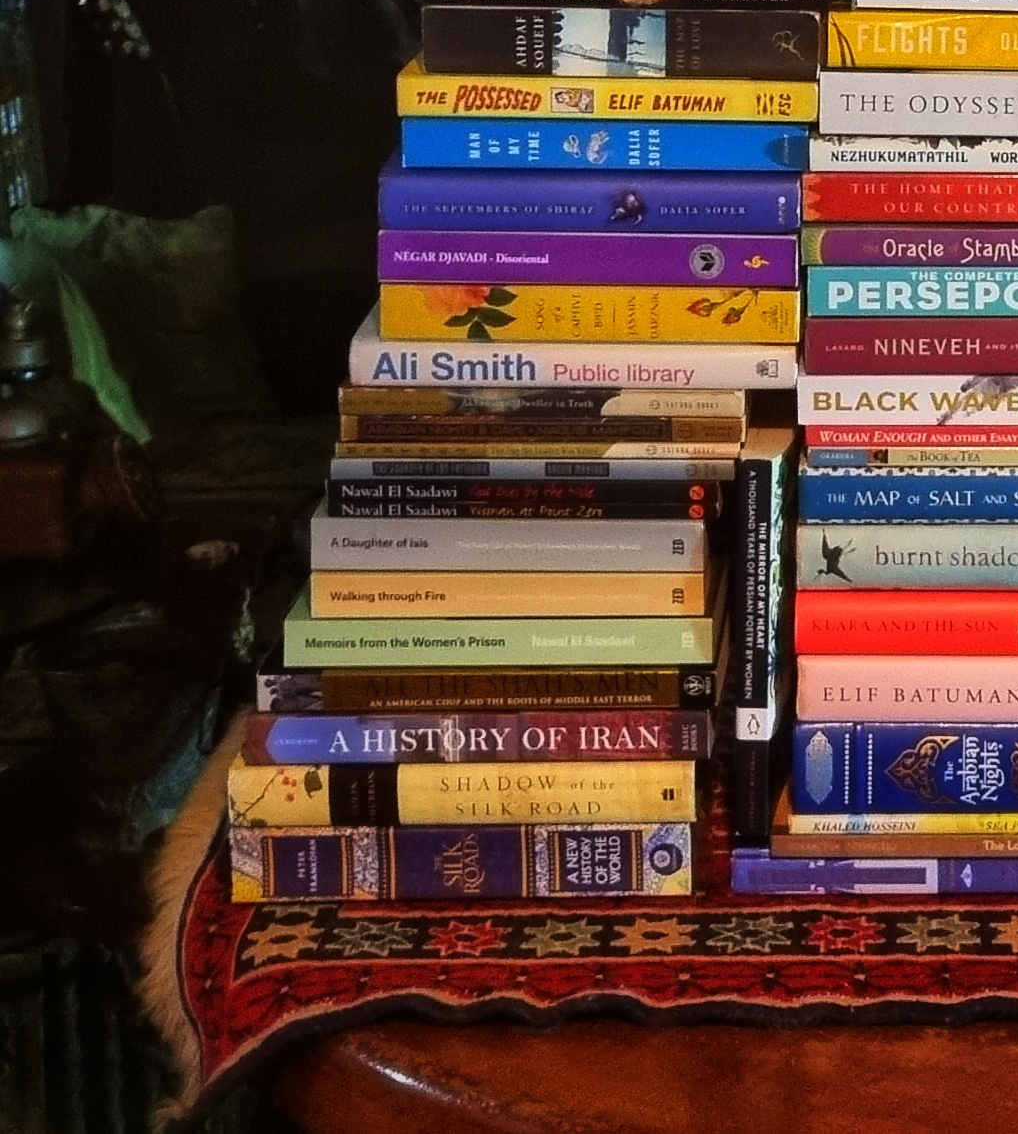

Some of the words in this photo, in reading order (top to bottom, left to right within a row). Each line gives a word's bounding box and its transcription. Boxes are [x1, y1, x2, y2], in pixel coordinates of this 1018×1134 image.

[416, 91, 447, 104] THE
[453, 85, 542, 113] POSSESSED
[608, 94, 643, 110] ELIF
[652, 95, 726, 112] BATUMAN
[840, 93, 895, 113] THE
[470, 132, 480, 159] MAN
[490, 139, 500, 153] OF
[510, 138, 519, 155] MY
[529, 132, 539, 160] TIME
[630, 129, 640, 165] DALIA
[649, 129, 660, 166] SOFER
[830, 151, 968, 163] NEZHUKUMATATHIL
[910, 271, 939, 280] THE
[372, 353, 417, 380] Ali
[431, 352, 536, 381] Smith
[553, 363, 621, 381] Public
[627, 364, 695, 385] library
[812, 391, 920, 412] BLACK
[827, 493, 846, 504] THE
[854, 490, 900, 506] MAP
[907, 494, 921, 505] OF
[929, 490, 974, 506] SALT
[982, 494, 1007, 505] AND
[876, 546, 942, 566] burnt
[305, 637, 355, 649] Memoirs
[359, 638, 387, 648] from
[390, 638, 409, 648] the
[468, 637, 505, 648] Prison
[823, 687, 878, 702] ELIF
[329, 731, 350, 753] A
[362, 728, 510, 752] HISTORY
[523, 727, 566, 749] OF
[579, 726, 661, 748] IRAN
